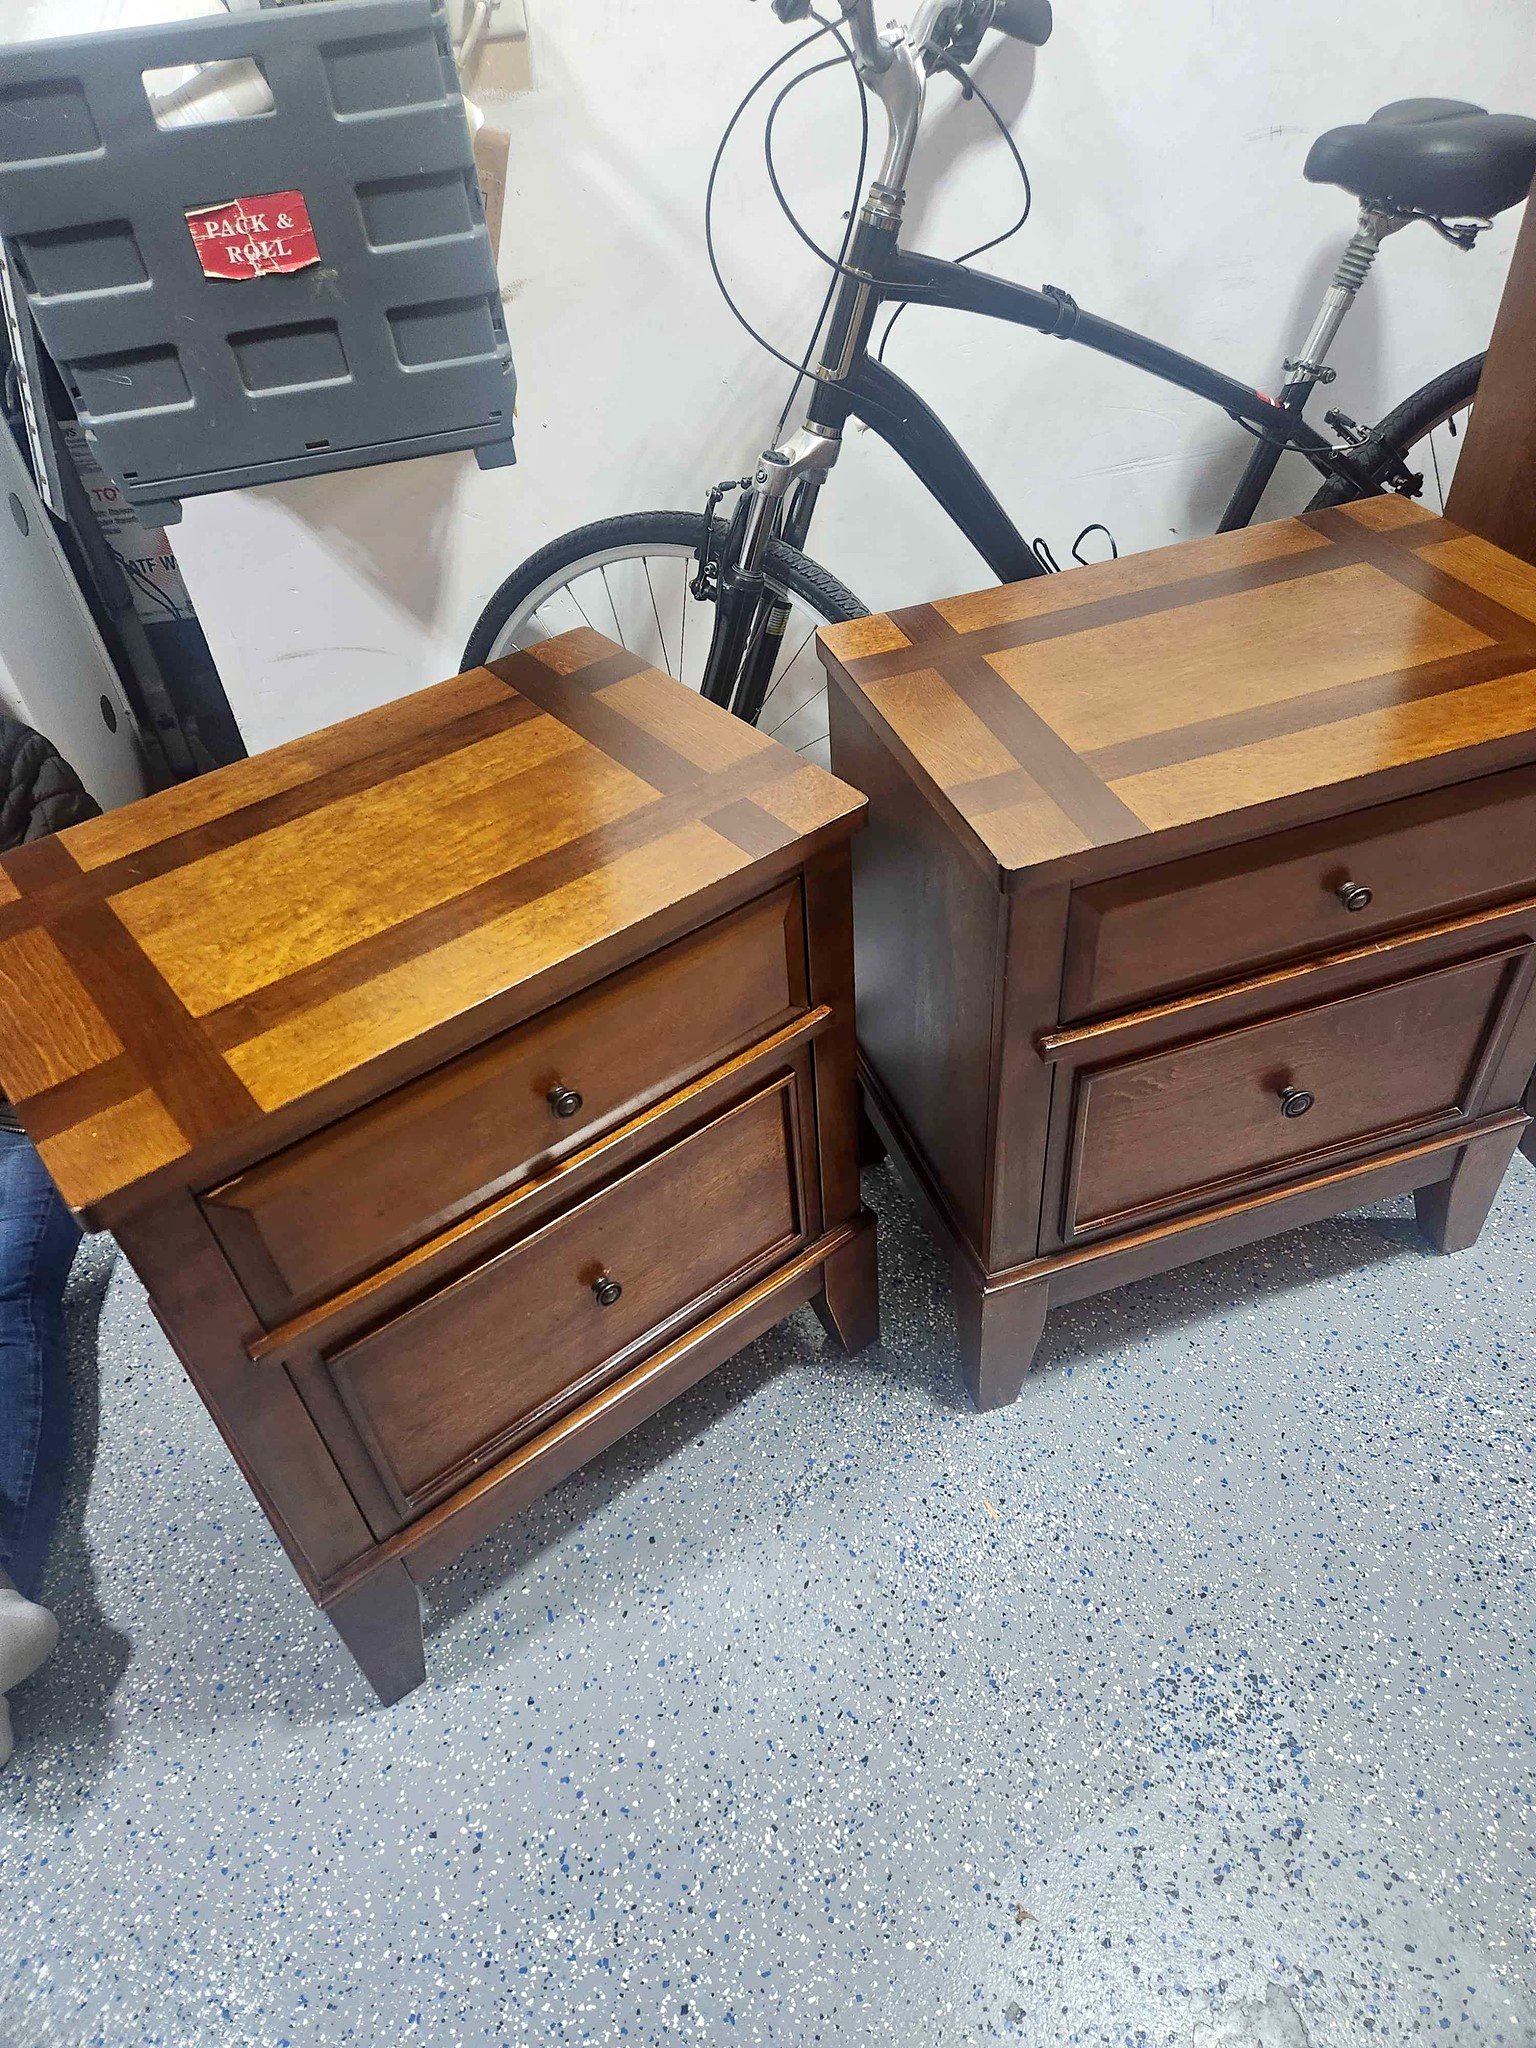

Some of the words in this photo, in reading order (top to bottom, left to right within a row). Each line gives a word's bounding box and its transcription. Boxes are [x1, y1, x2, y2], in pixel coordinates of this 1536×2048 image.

[203, 213, 270, 238] PACK
[276, 212, 295, 230] &
[225, 239, 292, 264] ROLL
